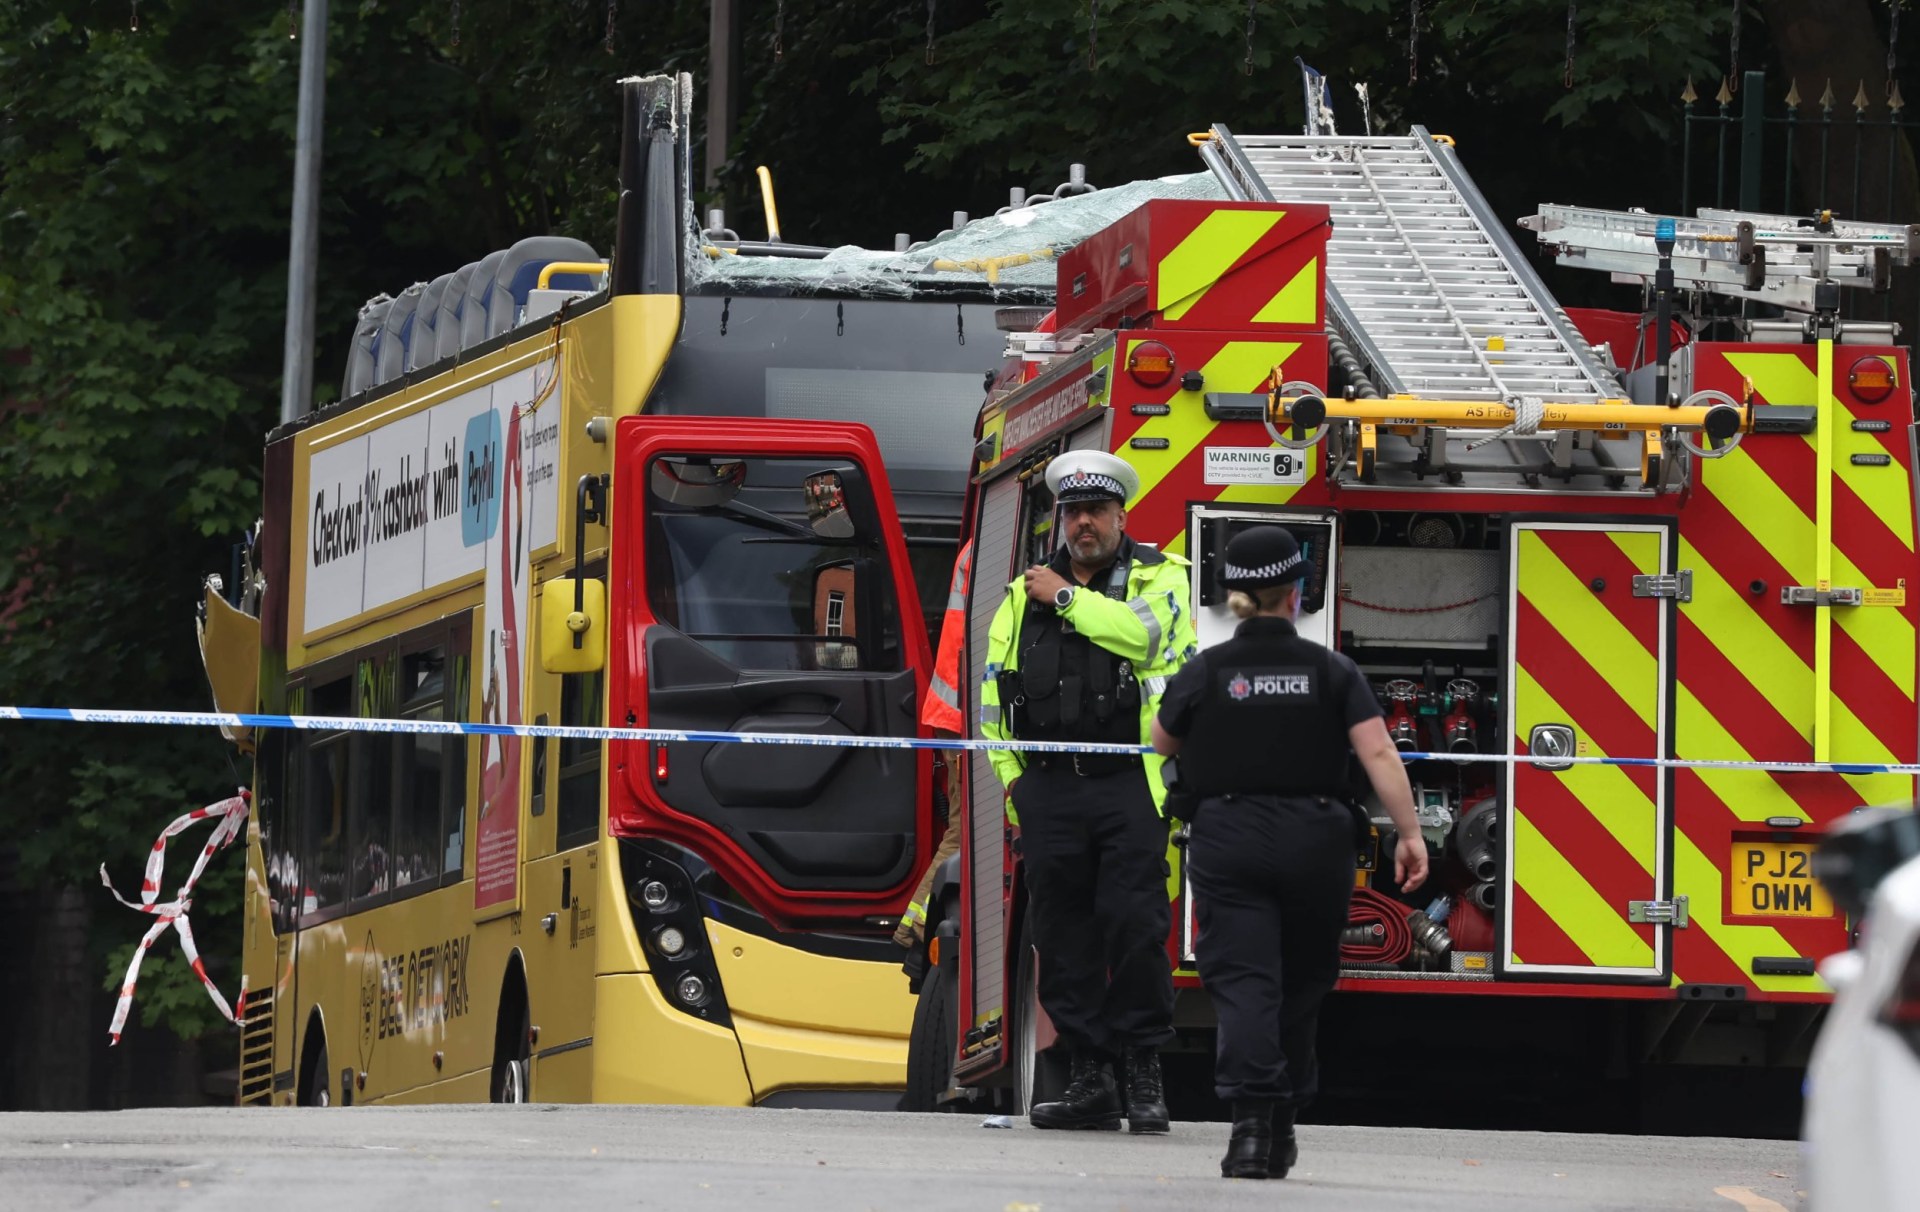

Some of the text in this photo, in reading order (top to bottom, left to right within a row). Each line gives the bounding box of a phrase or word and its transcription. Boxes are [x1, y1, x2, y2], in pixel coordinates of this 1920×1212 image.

[1466, 407, 1484, 417] AS
[1488, 407, 1511, 418] Fire
[1209, 452, 1271, 463] WARNING
[313, 482, 343, 568] Check
[344, 484, 362, 557] out
[383, 447, 430, 541] cashback
[433, 436, 459, 520] with
[467, 441, 495, 523] PayPal
[1899, 579, 1905, 589] 4
[1254, 681, 1309, 695] POLICE
[1748, 850, 1816, 879] PJ2
[1752, 883, 1812, 912] OWM
[379, 934, 471, 1040] BEE NETWORK
